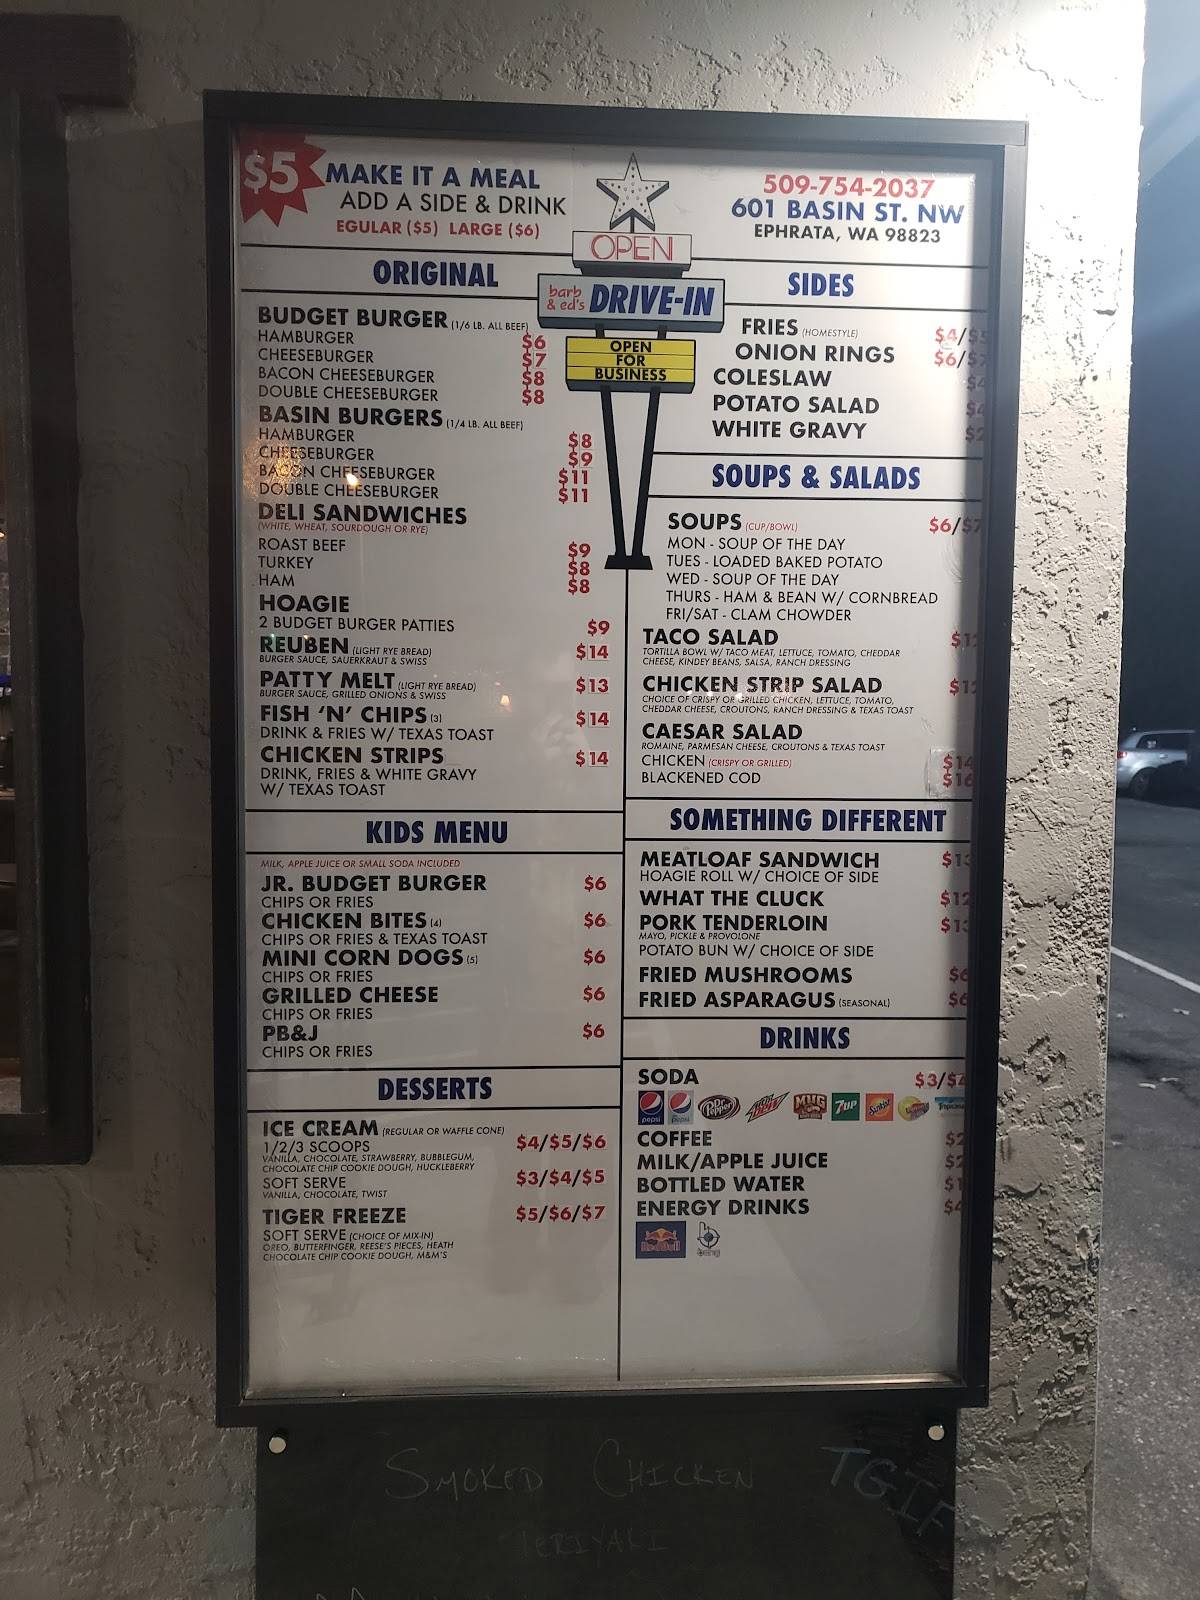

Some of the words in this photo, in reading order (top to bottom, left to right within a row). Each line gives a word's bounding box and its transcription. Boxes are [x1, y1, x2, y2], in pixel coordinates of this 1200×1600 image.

[244, 149, 299, 194] $5
[325, 163, 402, 186] MAKE
[413, 166, 433, 186] IT
[442, 167, 460, 186] A
[470, 168, 540, 189] MEAL
[764, 174, 936, 198] 509-754-2037
[340, 191, 388, 210] ADD
[396, 192, 412, 210] A
[421, 194, 466, 212] SIDE
[476, 195, 490, 213] &
[499, 196, 566, 216] DRINK
[732, 199, 774, 218] 601
[788, 201, 865, 220] BASIN
[875, 203, 907, 221] ST.
[918, 204, 965, 224] NW
[337, 220, 402, 234] EGULAR
[407, 220, 437, 237] ($5)
[450, 222, 502, 236] LARGE
[509, 222, 539, 240] ($6)
[753, 223, 841, 242] EPHRATA,
[848, 226, 879, 241] WA
[885, 227, 942, 243] 98823
[590, 234, 674, 262] OPEN
[374, 260, 498, 287] ORIGINAL
[548, 284, 583, 298] barb
[788, 272, 853, 297] SIDES
[546, 299, 557, 310] &
[560, 298, 585, 311] ed's
[589, 284, 715, 316] DRIVE-IN
[259, 307, 348, 325] BUDGET
[358, 309, 448, 328] BURGER
[488, 322, 502, 330] ALL
[505, 321, 529, 331] BEEF)
[259, 330, 354, 344] HAMBURGER
[742, 318, 798, 336] FRIES
[802, 328, 858, 339] (HOMESTYLE)
[522, 333, 546, 350] $6
[610, 339, 653, 353] OPEN
[259, 348, 373, 363] CHEESEBURGER
[522, 352, 547, 369] $7
[615, 354, 646, 367] FOR
[736, 343, 815, 361] ONION
[826, 346, 894, 363] RINGS
[259, 366, 313, 380] BACON
[320, 368, 434, 383] CHEESEBURGER
[522, 370, 545, 387] $8
[594, 367, 667, 381] BUSINESS
[714, 368, 832, 386] COLESLAW
[259, 385, 318, 398] DOUBLE
[324, 386, 438, 401] CHEESEBURGER
[522, 389, 545, 406] $8
[714, 395, 799, 412] POTATO
[808, 396, 879, 414] SALAD
[712, 420, 781, 437] WHITE
[790, 422, 866, 439] GRAVY
[713, 464, 790, 488] SOUPS
[802, 465, 820, 488] &
[830, 466, 920, 490] SALADS
[258, 503, 304, 521] DELI
[313, 505, 467, 524] SANDWICHES
[668, 513, 741, 530] SOUPS
[746, 522, 797, 532] (CUP/BOWL)
[259, 538, 308, 550] ROAST
[313, 539, 345, 552] BEEF
[258, 556, 313, 569] TURKEY
[667, 555, 700, 566] TUES
[714, 556, 770, 567] LOADED
[776, 556, 822, 568] BAKED
[828, 556, 882, 568] POTATO
[260, 574, 294, 586] HAM
[260, 594, 349, 612] HOAGIE
[643, 628, 700, 645] TACO
[709, 629, 779, 646] SALAD
[260, 636, 349, 654] REUBEN
[352, 647, 380, 657] (LIGHT
[382, 648, 398, 656] RYE
[401, 648, 432, 658] BREAD)
[259, 655, 295, 664] BURGER
[297, 656, 329, 665] SAUCE,
[331, 656, 388, 665] SAUERKRAUT
[391, 657, 397, 665] &
[400, 657, 427, 666] SWISS
[642, 657, 675, 667] CHEESE,
[678, 657, 710, 666] KINDEY
[713, 658, 741, 667] BEANS,
[744, 658, 771, 667] SALSA,
[776, 658, 806, 667] RANCH
[809, 658, 851, 667] DRESSING
[642, 722, 724, 740] CAESAR
[733, 723, 803, 740] SALAD
[261, 746, 361, 763] CHICKEN
[371, 747, 443, 764] STRIPS
[642, 772, 723, 783] BLACKENED
[729, 772, 760, 783] COD
[670, 808, 812, 831] SOMETHING
[822, 810, 946, 832] DIFFERENT
[367, 821, 423, 843] KIDS
[434, 821, 507, 843] MENU
[640, 851, 752, 868] MEATLOAF
[759, 852, 879, 869] SANDWICH
[262, 876, 293, 892] JR.
[303, 875, 390, 891] BUDGET
[399, 875, 486, 891] BURGER
[584, 875, 607, 892] $6
[262, 896, 303, 908] CHIPS
[310, 896, 330, 908] OR
[337, 896, 373, 908] FRIES
[640, 890, 704, 906] WHAT
[711, 890, 748, 906] THE
[756, 890, 824, 906] CLUCK
[640, 914, 695, 931] PORK
[703, 914, 828, 931] TENDERLOIN
[263, 987, 351, 1004] GRILLED
[360, 986, 438, 1003] CHEESE
[583, 986, 606, 1003] $6
[640, 992, 696, 1007] FRIED
[704, 992, 836, 1008] ASPARAGUS
[839, 998, 890, 1008] (SEASONAL)
[263, 1025, 317, 1041] PB&J
[761, 1027, 850, 1049] DRINKS
[638, 1069, 699, 1085] SODA
[379, 1077, 492, 1100] DESSERTS
[795, 1095, 826, 1109] MUG
[263, 1121, 294, 1137] ICE
[302, 1120, 378, 1136] CREAM
[517, 1133, 606, 1152] $4/$5/$6
[638, 1131, 712, 1147] COFFEE
[637, 1152, 763, 1172] MILK/APPLE
[771, 1153, 827, 1168] JUICE
[638, 1177, 725, 1193] BOTTLED
[733, 1176, 804, 1191] WATER
[262, 1190, 300, 1200] VANILLA,
[303, 1190, 358, 1199] CHOCOLATE,
[362, 1190, 387, 1199] TWIST
[263, 1209, 324, 1224] TIGER
[333, 1208, 406, 1224] FREEZE
[516, 1204, 605, 1223] $5/$6/$7
[638, 1200, 721, 1216] ENERGY
[729, 1199, 809, 1215] DRINKS
